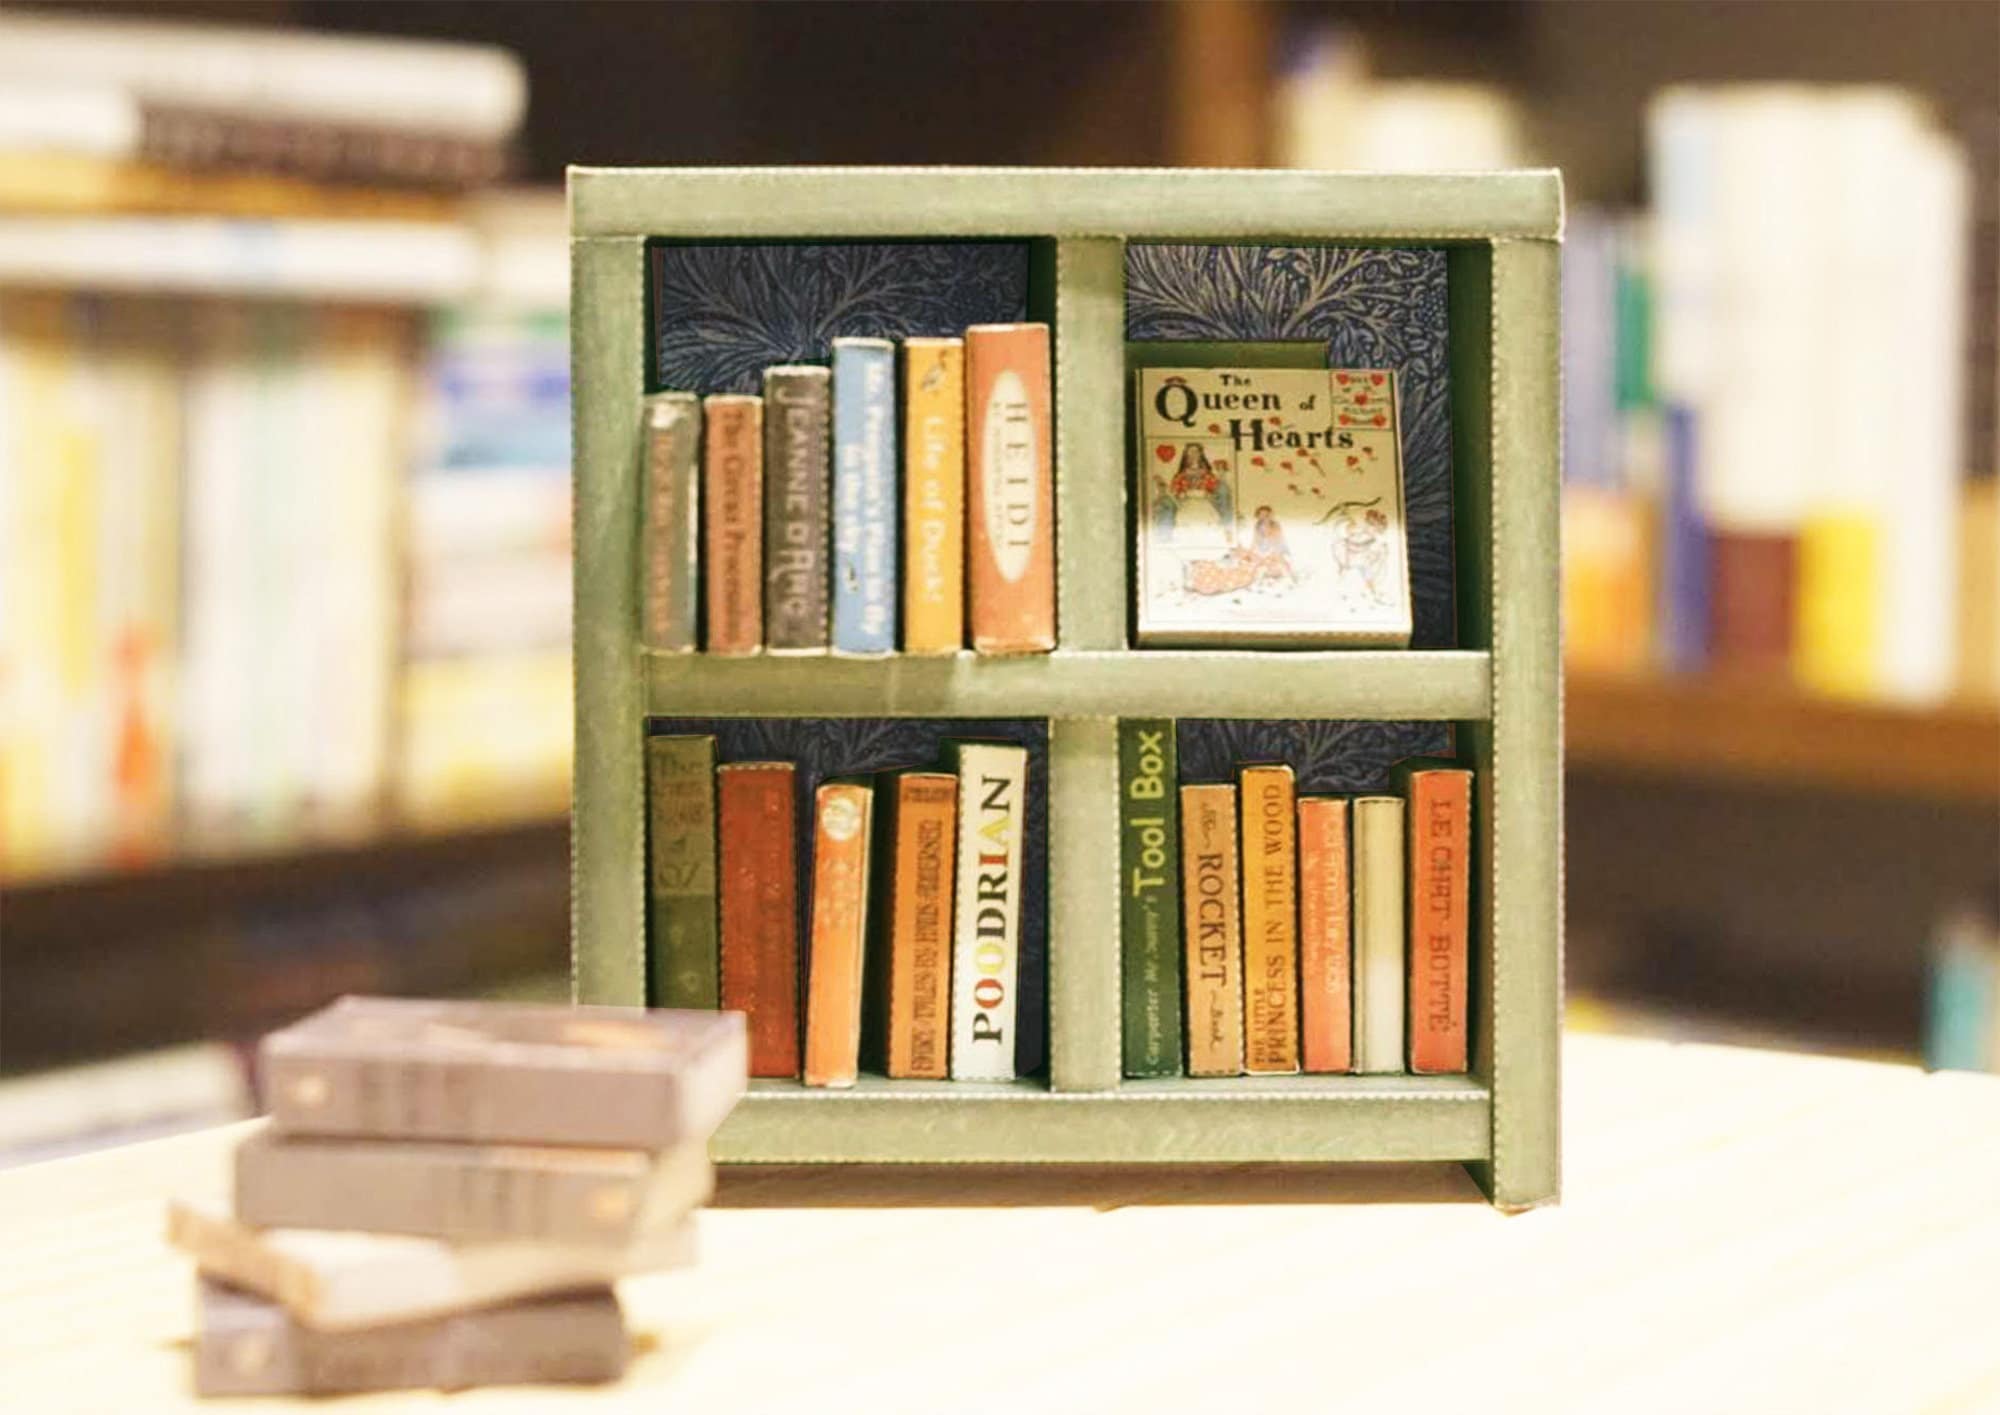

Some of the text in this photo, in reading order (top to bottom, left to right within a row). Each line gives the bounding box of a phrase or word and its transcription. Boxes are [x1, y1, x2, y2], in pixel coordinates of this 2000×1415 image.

[1155, 382, 1281, 427] Queen
[1299, 395, 1317, 411] of
[1219, 374, 1252, 387] The
[776, 386, 816, 512] JEANNE
[921, 415, 944, 470] Life
[1229, 419, 1354, 451] Hearts
[923, 479, 945, 509] of
[1004, 401, 1030, 550] HEIDI
[1130, 730, 1166, 800] Box
[1430, 798, 1453, 838] LE
[1130, 818, 1166, 896] Tool
[972, 774, 1013, 1045] POODRIAN
[1196, 852, 1228, 987] ROCKET
[1261, 783, 1288, 1064] PRINCESS IN THE WOOD
[1253, 987, 1267, 1064] THE LITTLE
